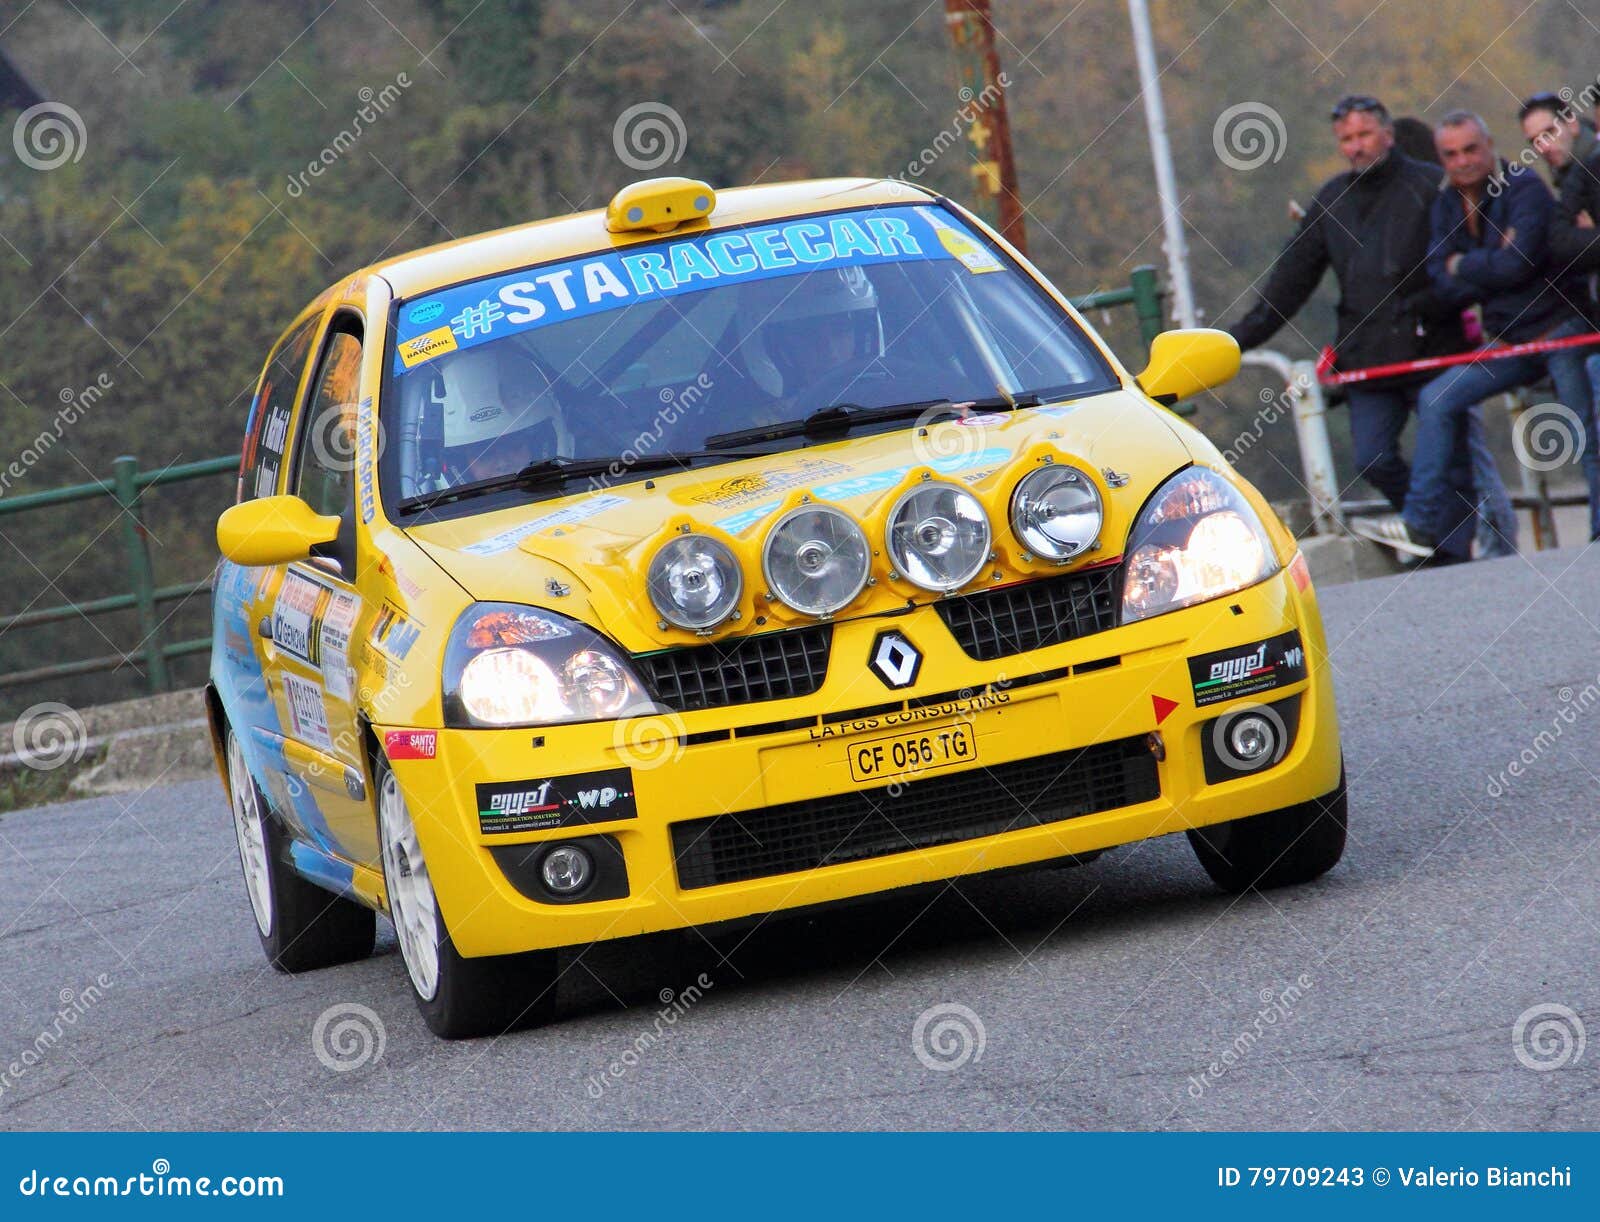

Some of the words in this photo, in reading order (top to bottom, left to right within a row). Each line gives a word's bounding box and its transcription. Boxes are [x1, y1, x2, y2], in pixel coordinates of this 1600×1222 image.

[450, 216, 924, 339] #STARACECAR
[406, 338, 453, 359] BARDAHL
[809, 726, 837, 741] LA
[840, 718, 880, 735] FGS
[885, 692, 1011, 725] CONSULTING
[857, 745, 885, 776] CF
[892, 736, 934, 769] 056
[937, 730, 968, 760] TG
[577, 786, 618, 810] WP
